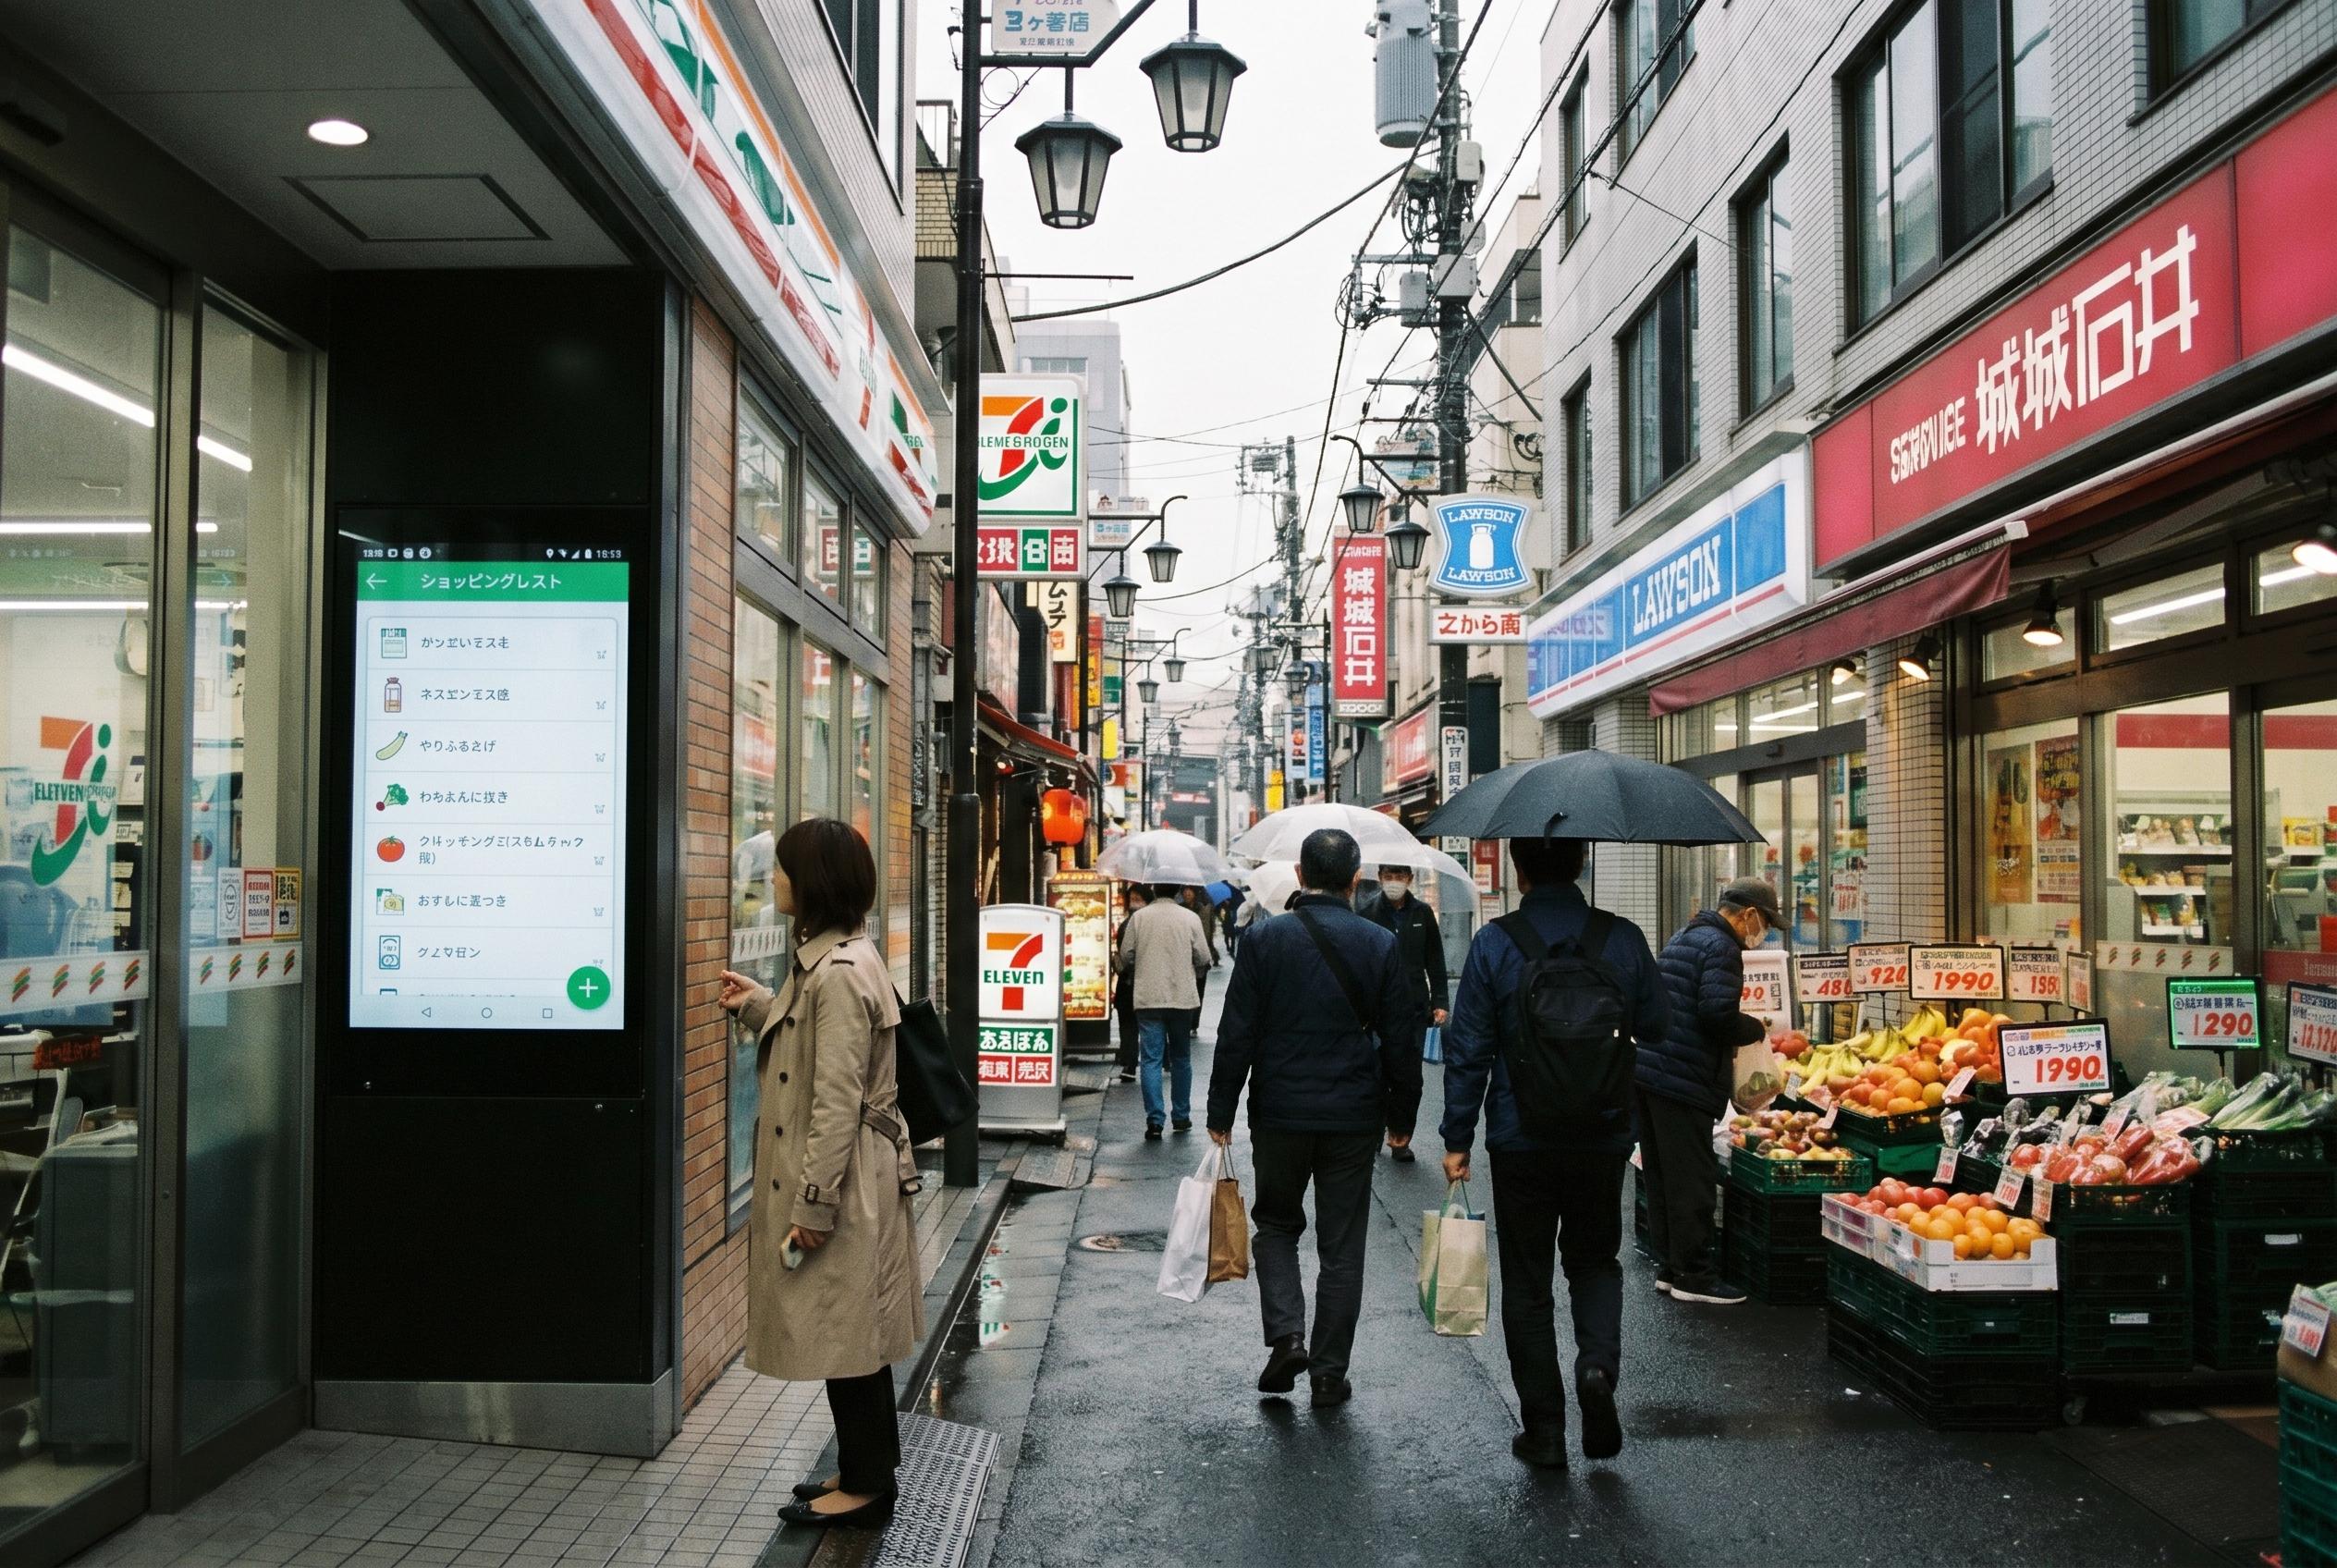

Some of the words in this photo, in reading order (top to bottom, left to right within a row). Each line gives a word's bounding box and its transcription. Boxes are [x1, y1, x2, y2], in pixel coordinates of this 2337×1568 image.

[1447, 508, 1516, 523] LAWSON
[1447, 567, 1516, 582] LAWSON
[1633, 534, 1721, 636] LAWSON
[1934, 972, 1995, 991] 1990
[2194, 1012, 2254, 1036] 1290
[2036, 1055, 2101, 1083] 1990
